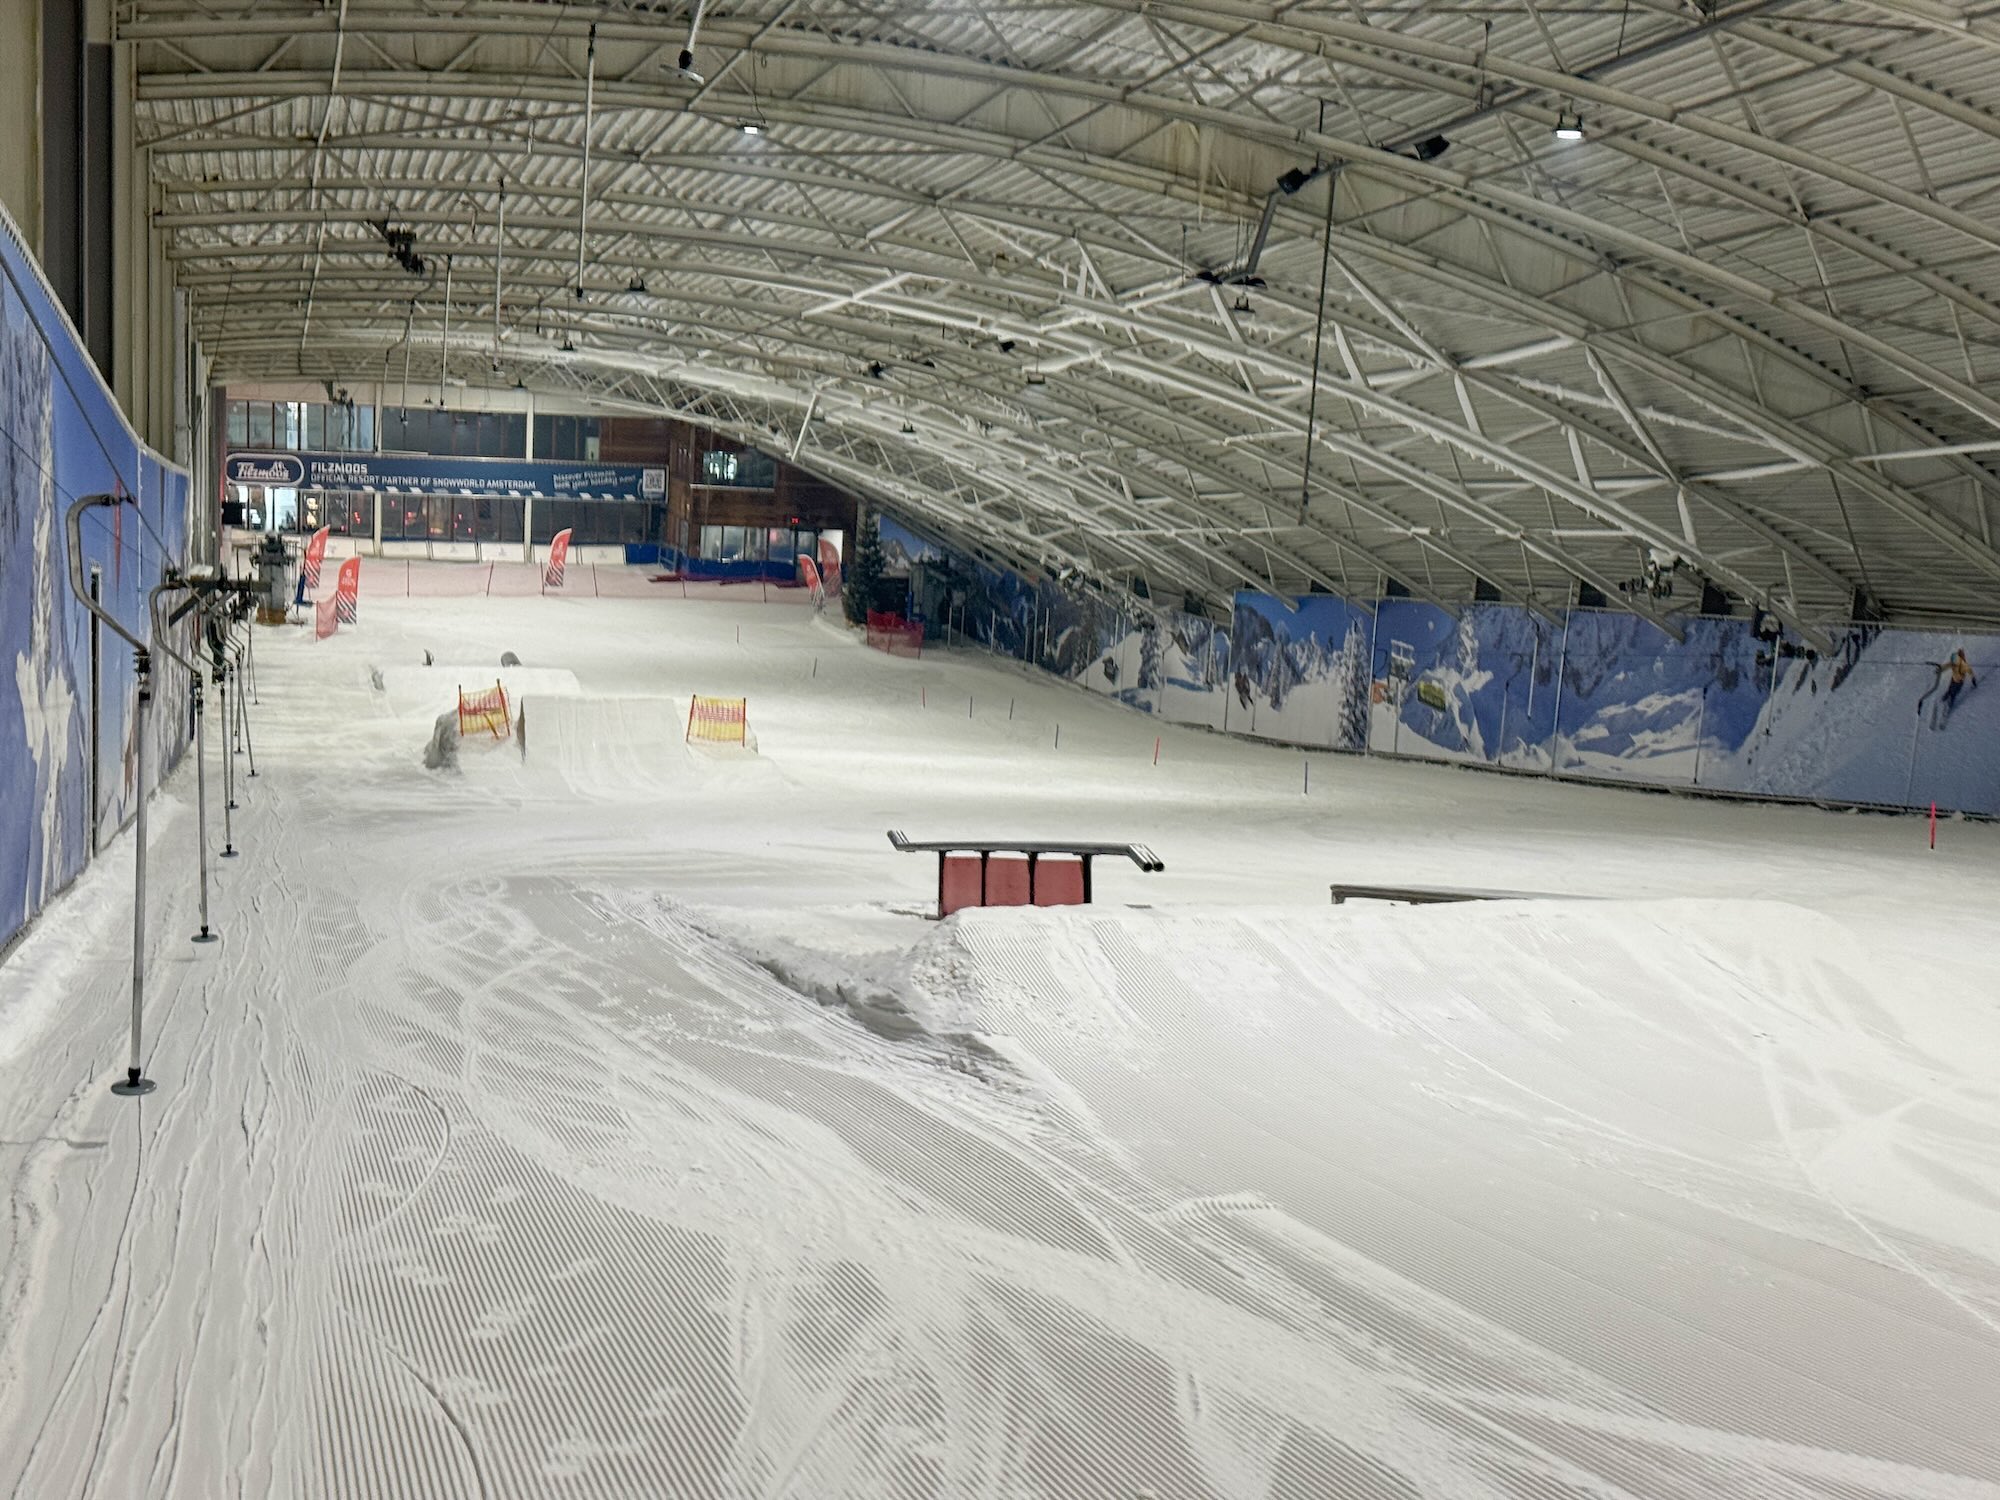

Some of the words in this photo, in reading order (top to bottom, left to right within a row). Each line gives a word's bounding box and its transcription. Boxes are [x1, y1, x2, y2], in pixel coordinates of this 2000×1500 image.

[237, 461, 290, 480] Filzmoos
[311, 462, 368, 474] FILZMOOS
[311, 473, 345, 483] OFFICIAL
[348, 474, 379, 484] RESORT
[381, 475, 419, 486] PARTNER
[421, 477, 432, 486] OF
[433, 477, 485, 488] SNOWWORLD
[486, 479, 537, 489] AMSTERDAM
